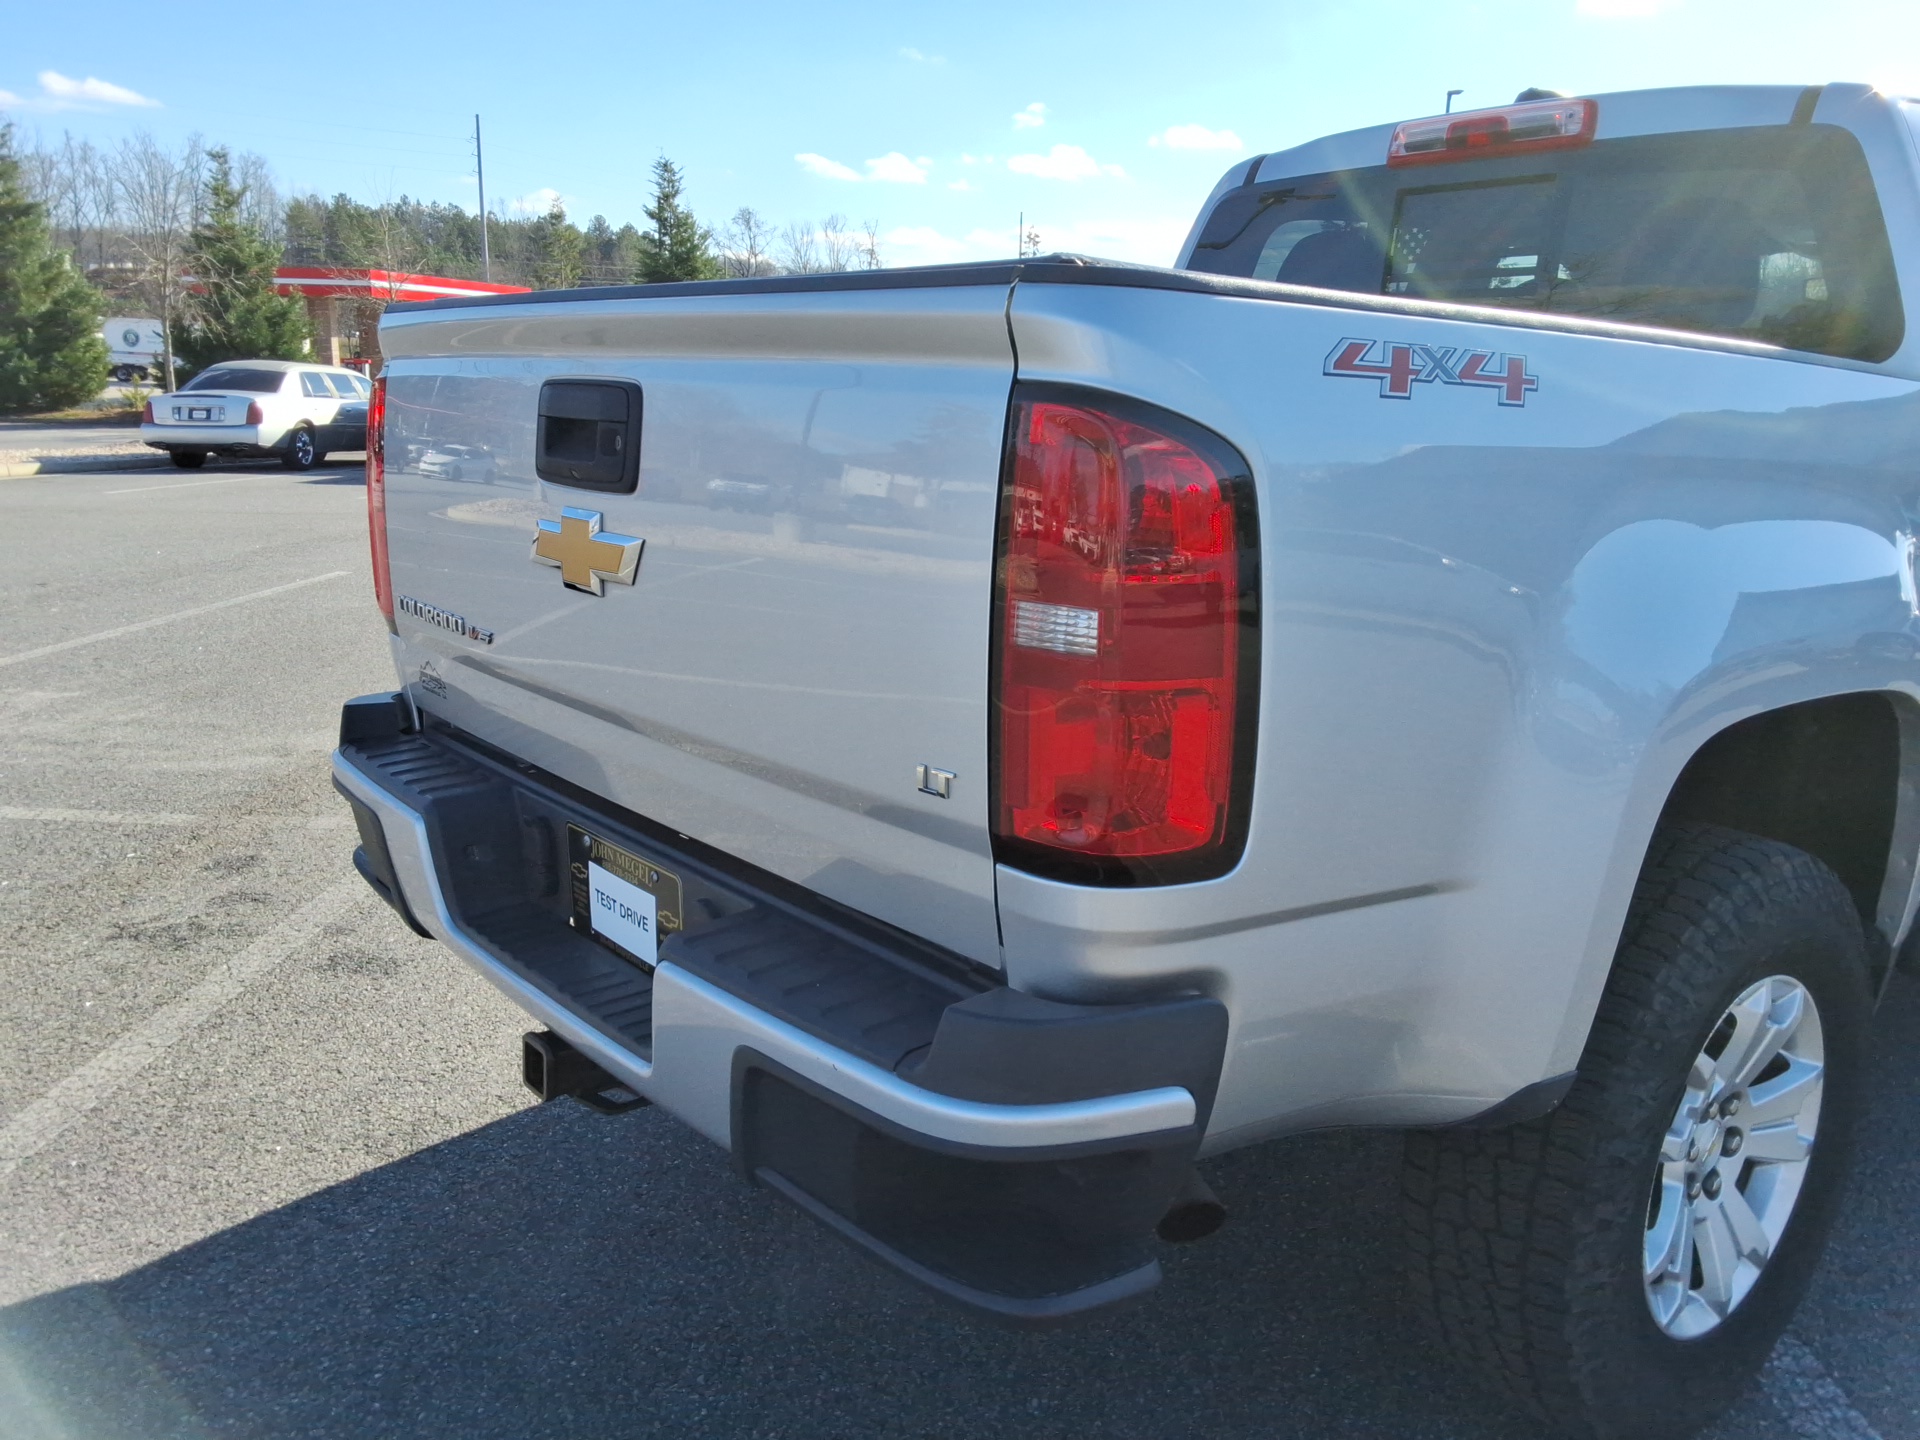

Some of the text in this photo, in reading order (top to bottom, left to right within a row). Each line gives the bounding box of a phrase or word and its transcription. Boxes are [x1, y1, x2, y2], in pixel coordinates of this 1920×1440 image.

[916, 763, 957, 799] LT
[590, 838, 614, 861] JOHN
[594, 887, 617, 914] TEST
[619, 902, 650, 933] DRIVE
